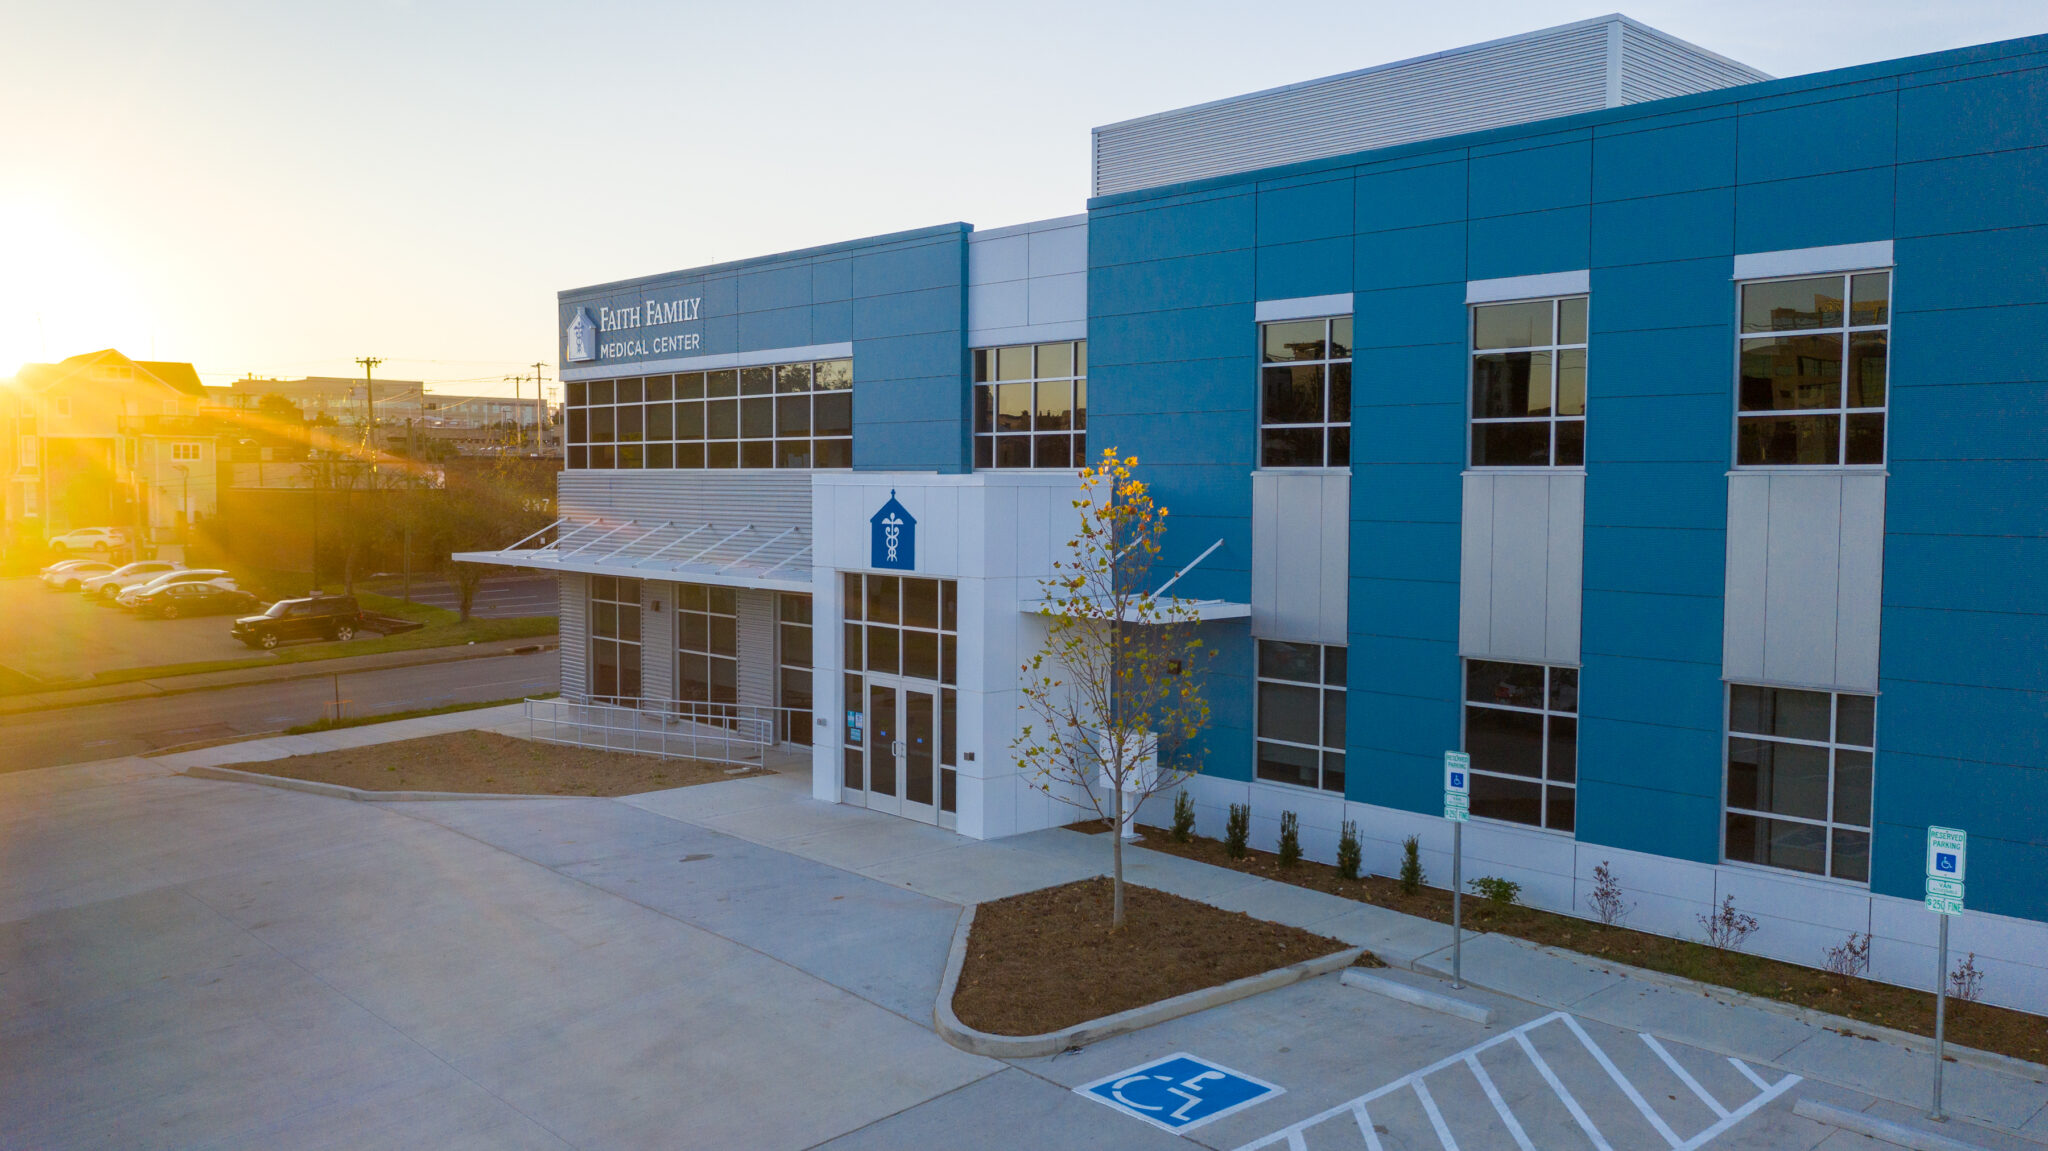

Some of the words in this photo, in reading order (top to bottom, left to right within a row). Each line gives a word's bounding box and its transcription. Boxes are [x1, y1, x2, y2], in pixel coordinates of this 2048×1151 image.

[600, 341, 649, 359] MEDICAL
[653, 333, 700, 353] CENTER
[1930, 831, 1963, 842] RESERVED
[1932, 840, 1961, 850] PARKING
[1947, 901, 1963, 913] FINE
